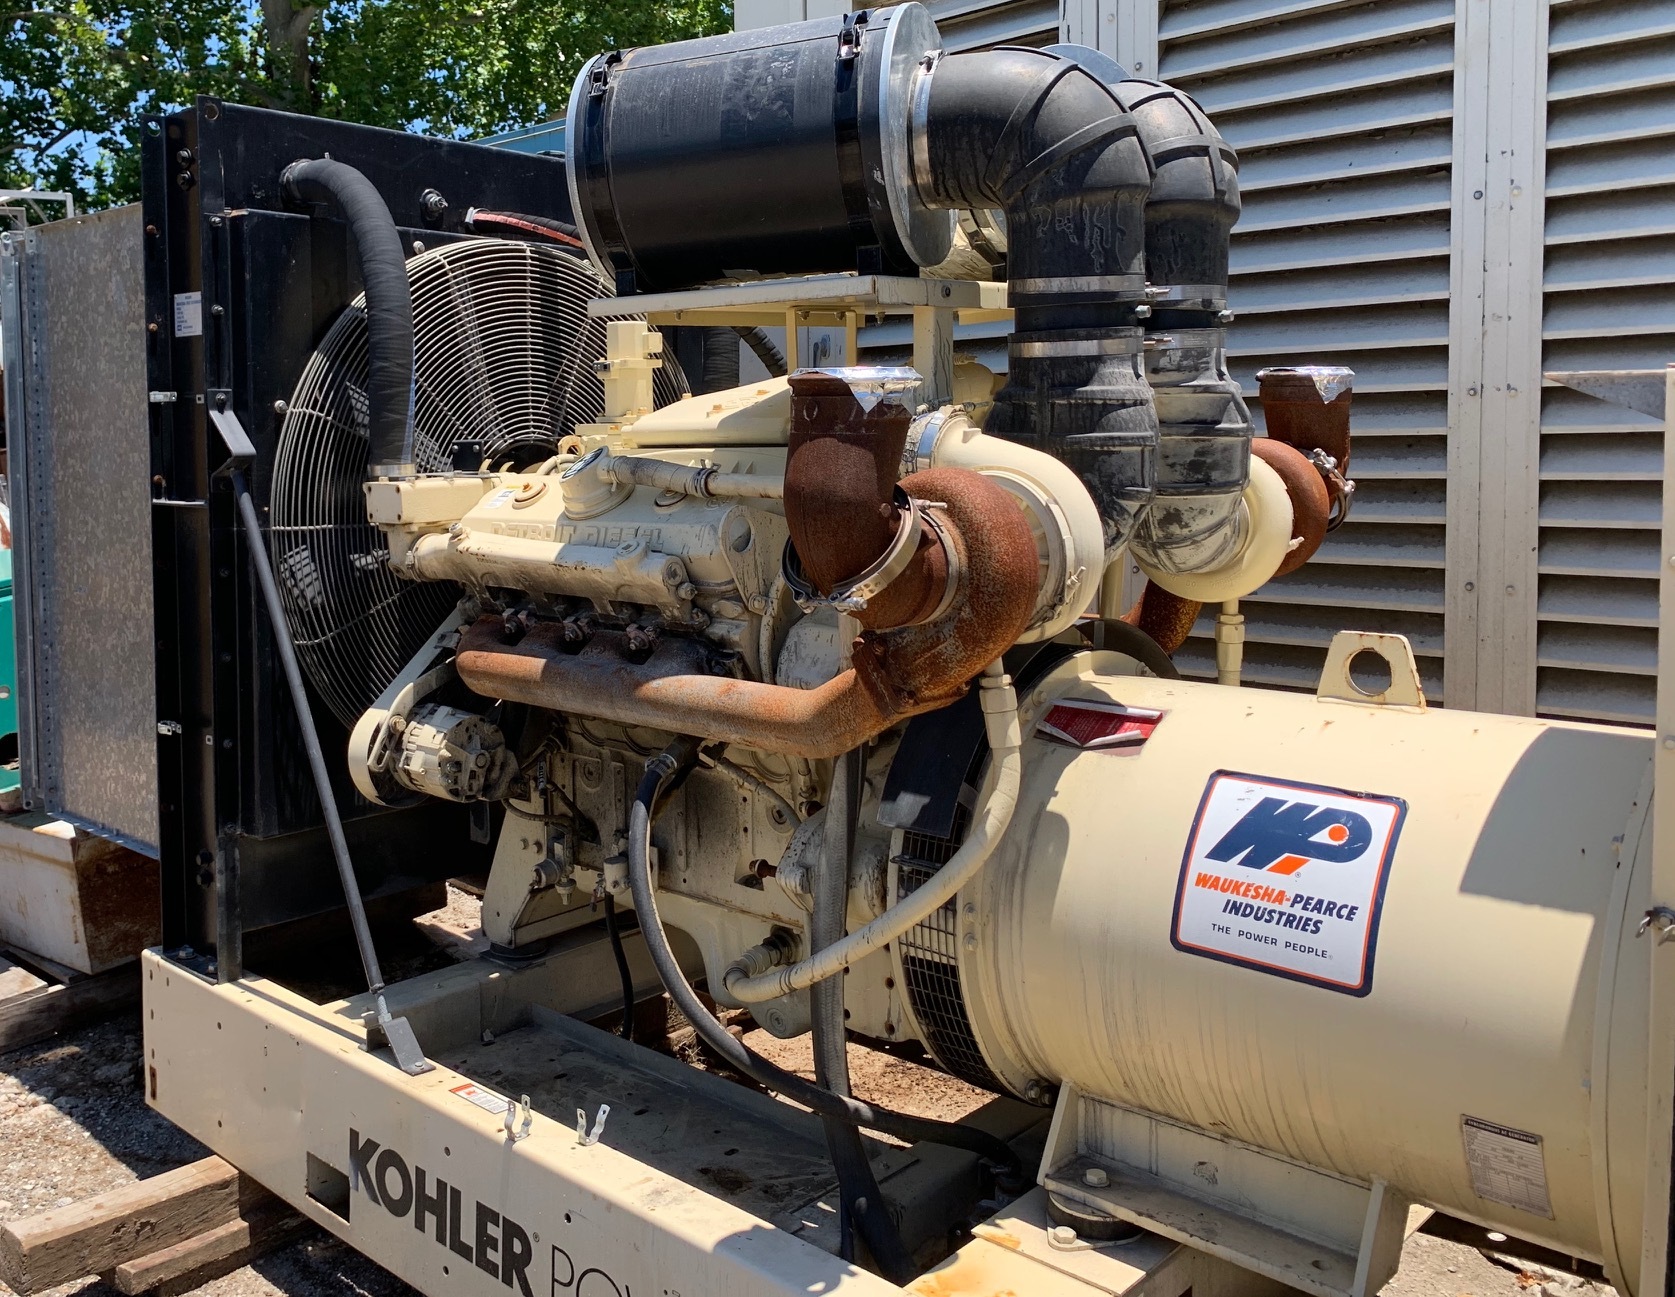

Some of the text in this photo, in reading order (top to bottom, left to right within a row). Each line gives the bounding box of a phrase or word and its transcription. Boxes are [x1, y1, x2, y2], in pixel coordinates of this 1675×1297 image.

[490, 522, 664, 551] DETROIT DIESEL
[1194, 872, 1359, 921] WAUKESHA-PEARCE
[1222, 899, 1323, 935] INDUSTRIES
[1211, 923, 1328, 959] THE POWER PEOPLE
[349, 1128, 534, 1297] KOHLER
